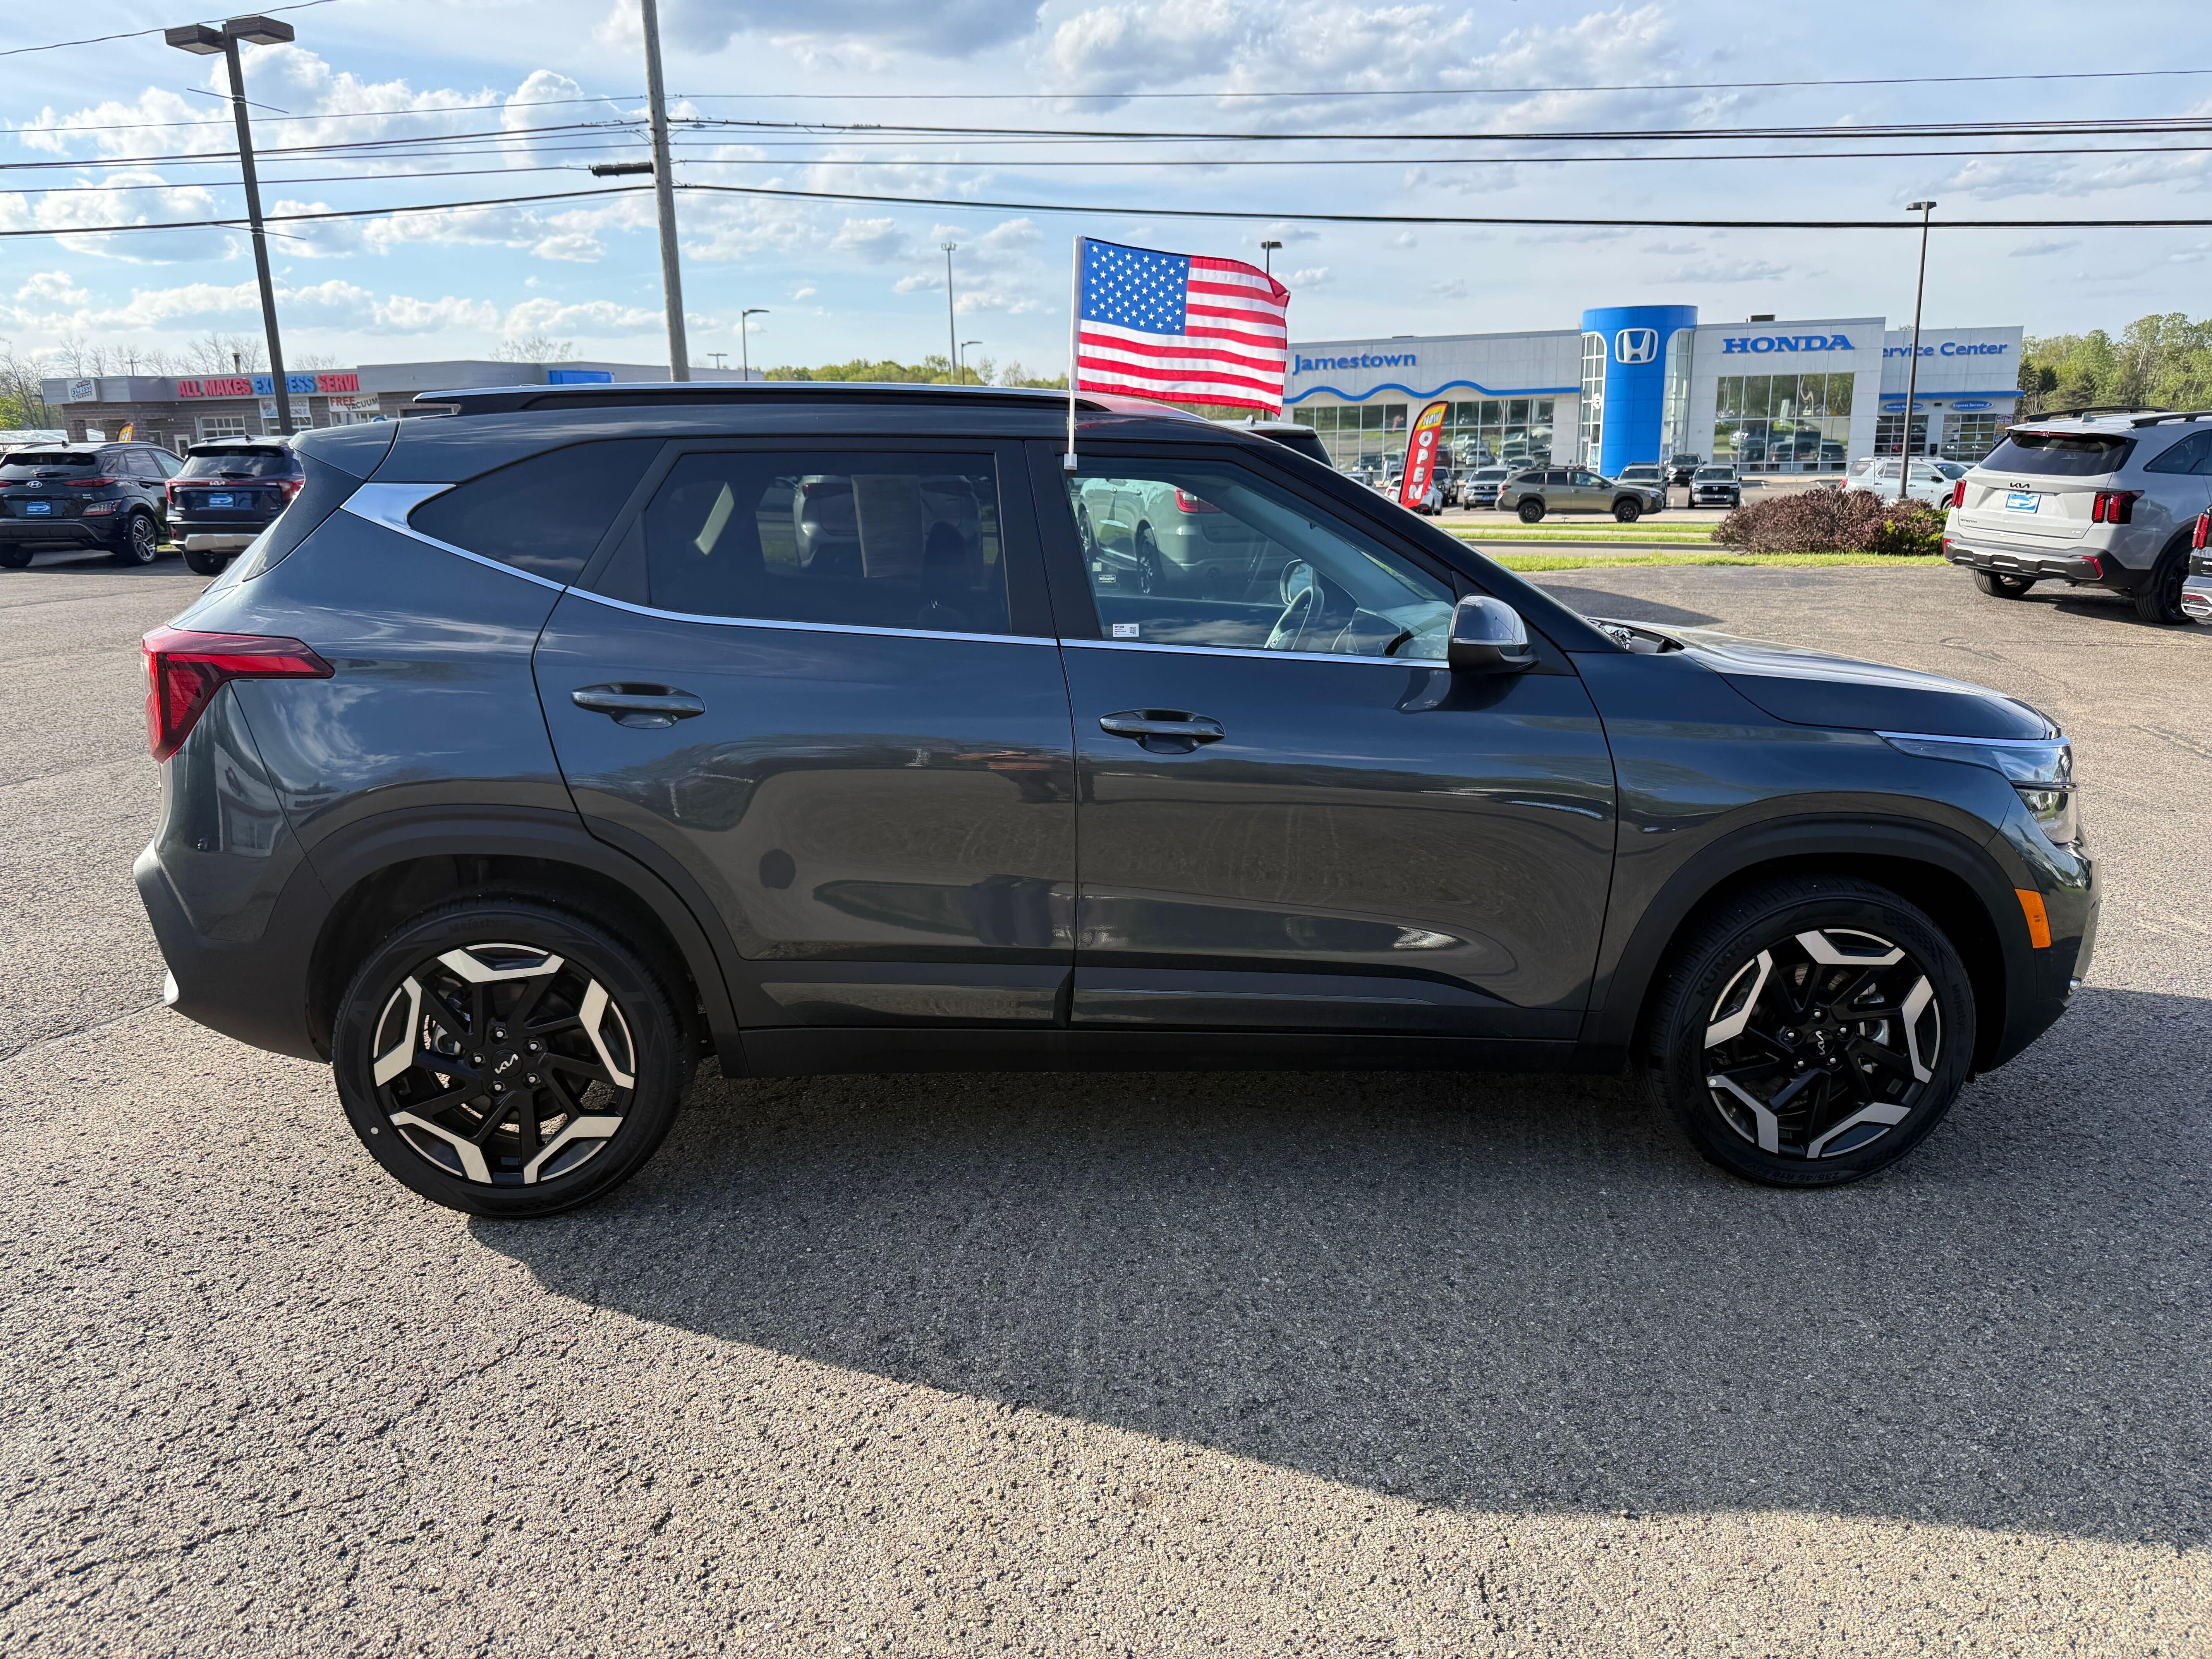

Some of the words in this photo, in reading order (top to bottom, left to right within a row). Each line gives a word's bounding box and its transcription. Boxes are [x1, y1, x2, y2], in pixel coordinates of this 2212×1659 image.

[1723, 335, 1855, 354] HONDA
[1883, 343, 1934, 357] ervice
[1940, 342, 2008, 356] Center
[1292, 354, 1416, 376] Jamestown
[178, 380, 203, 397] ALL
[203, 378, 253, 397] MAKES
[253, 375, 316, 395] EXESS
[317, 373, 360, 392] SERVI
[329, 396, 355, 407] FREE
[346, 397, 379, 411] VACUUM
[1422, 412, 1441, 426] NOW
[1407, 430, 1433, 500] OPEN
[1815, 1031, 1826, 1055] KIA
[495, 1053, 519, 1074] KIA
